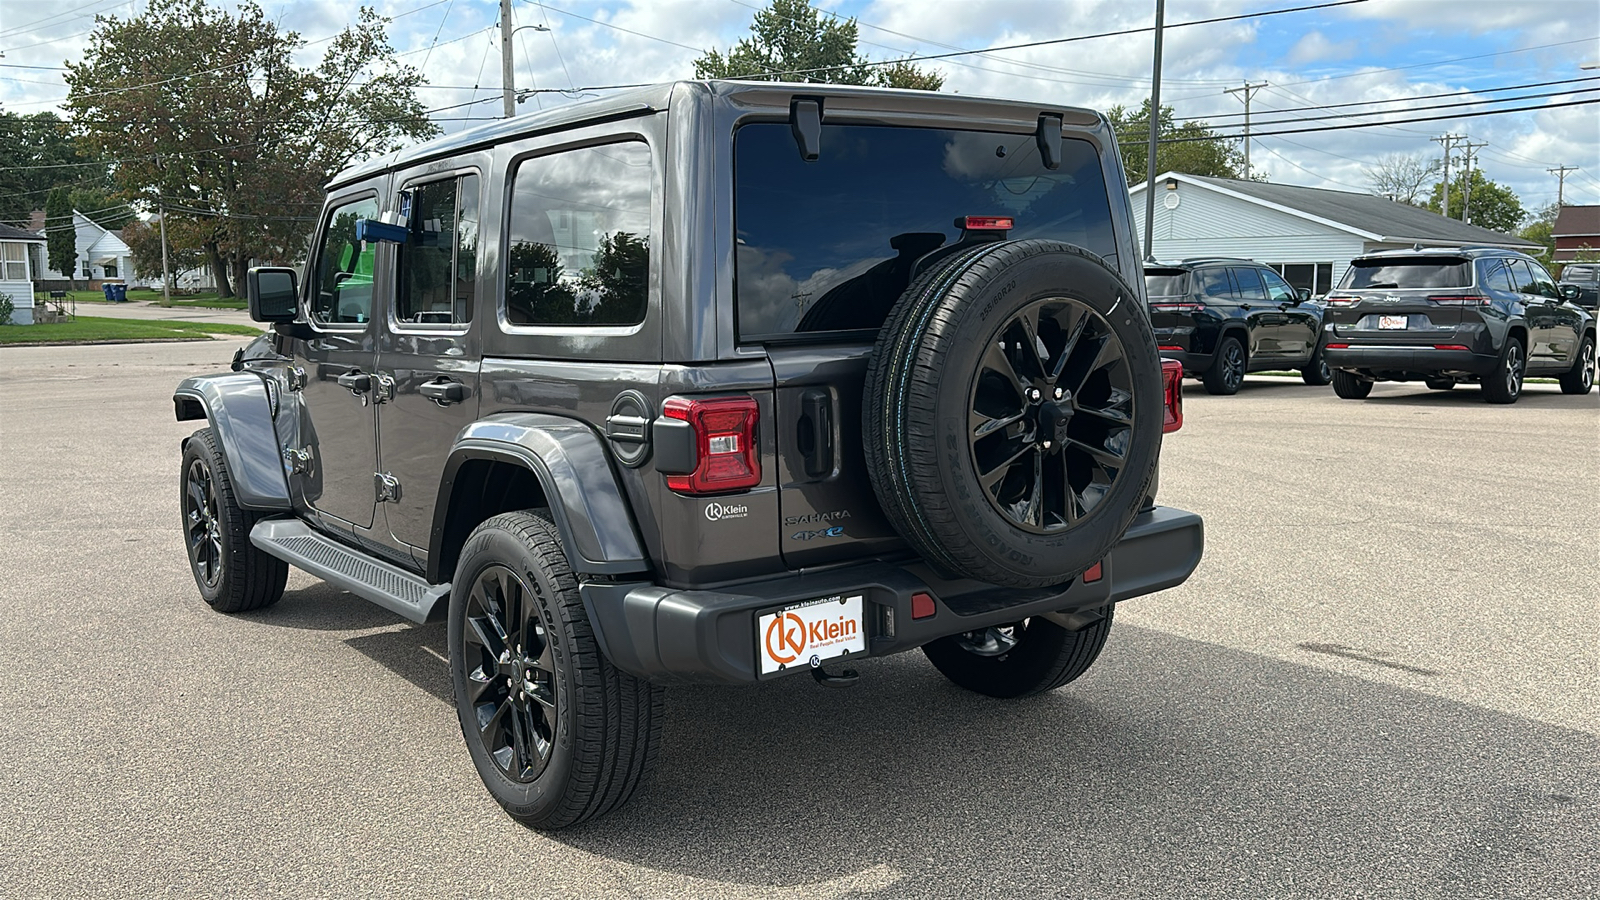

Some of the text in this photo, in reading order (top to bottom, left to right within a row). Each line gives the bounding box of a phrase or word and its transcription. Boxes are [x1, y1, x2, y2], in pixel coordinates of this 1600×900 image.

[979, 279, 1017, 322] 255/60R20
[723, 504, 748, 515] Klein
[785, 510, 852, 526] SAHARA
[784, 595, 841, 611] www.kleinauto.com
[809, 616, 857, 643] Klein
